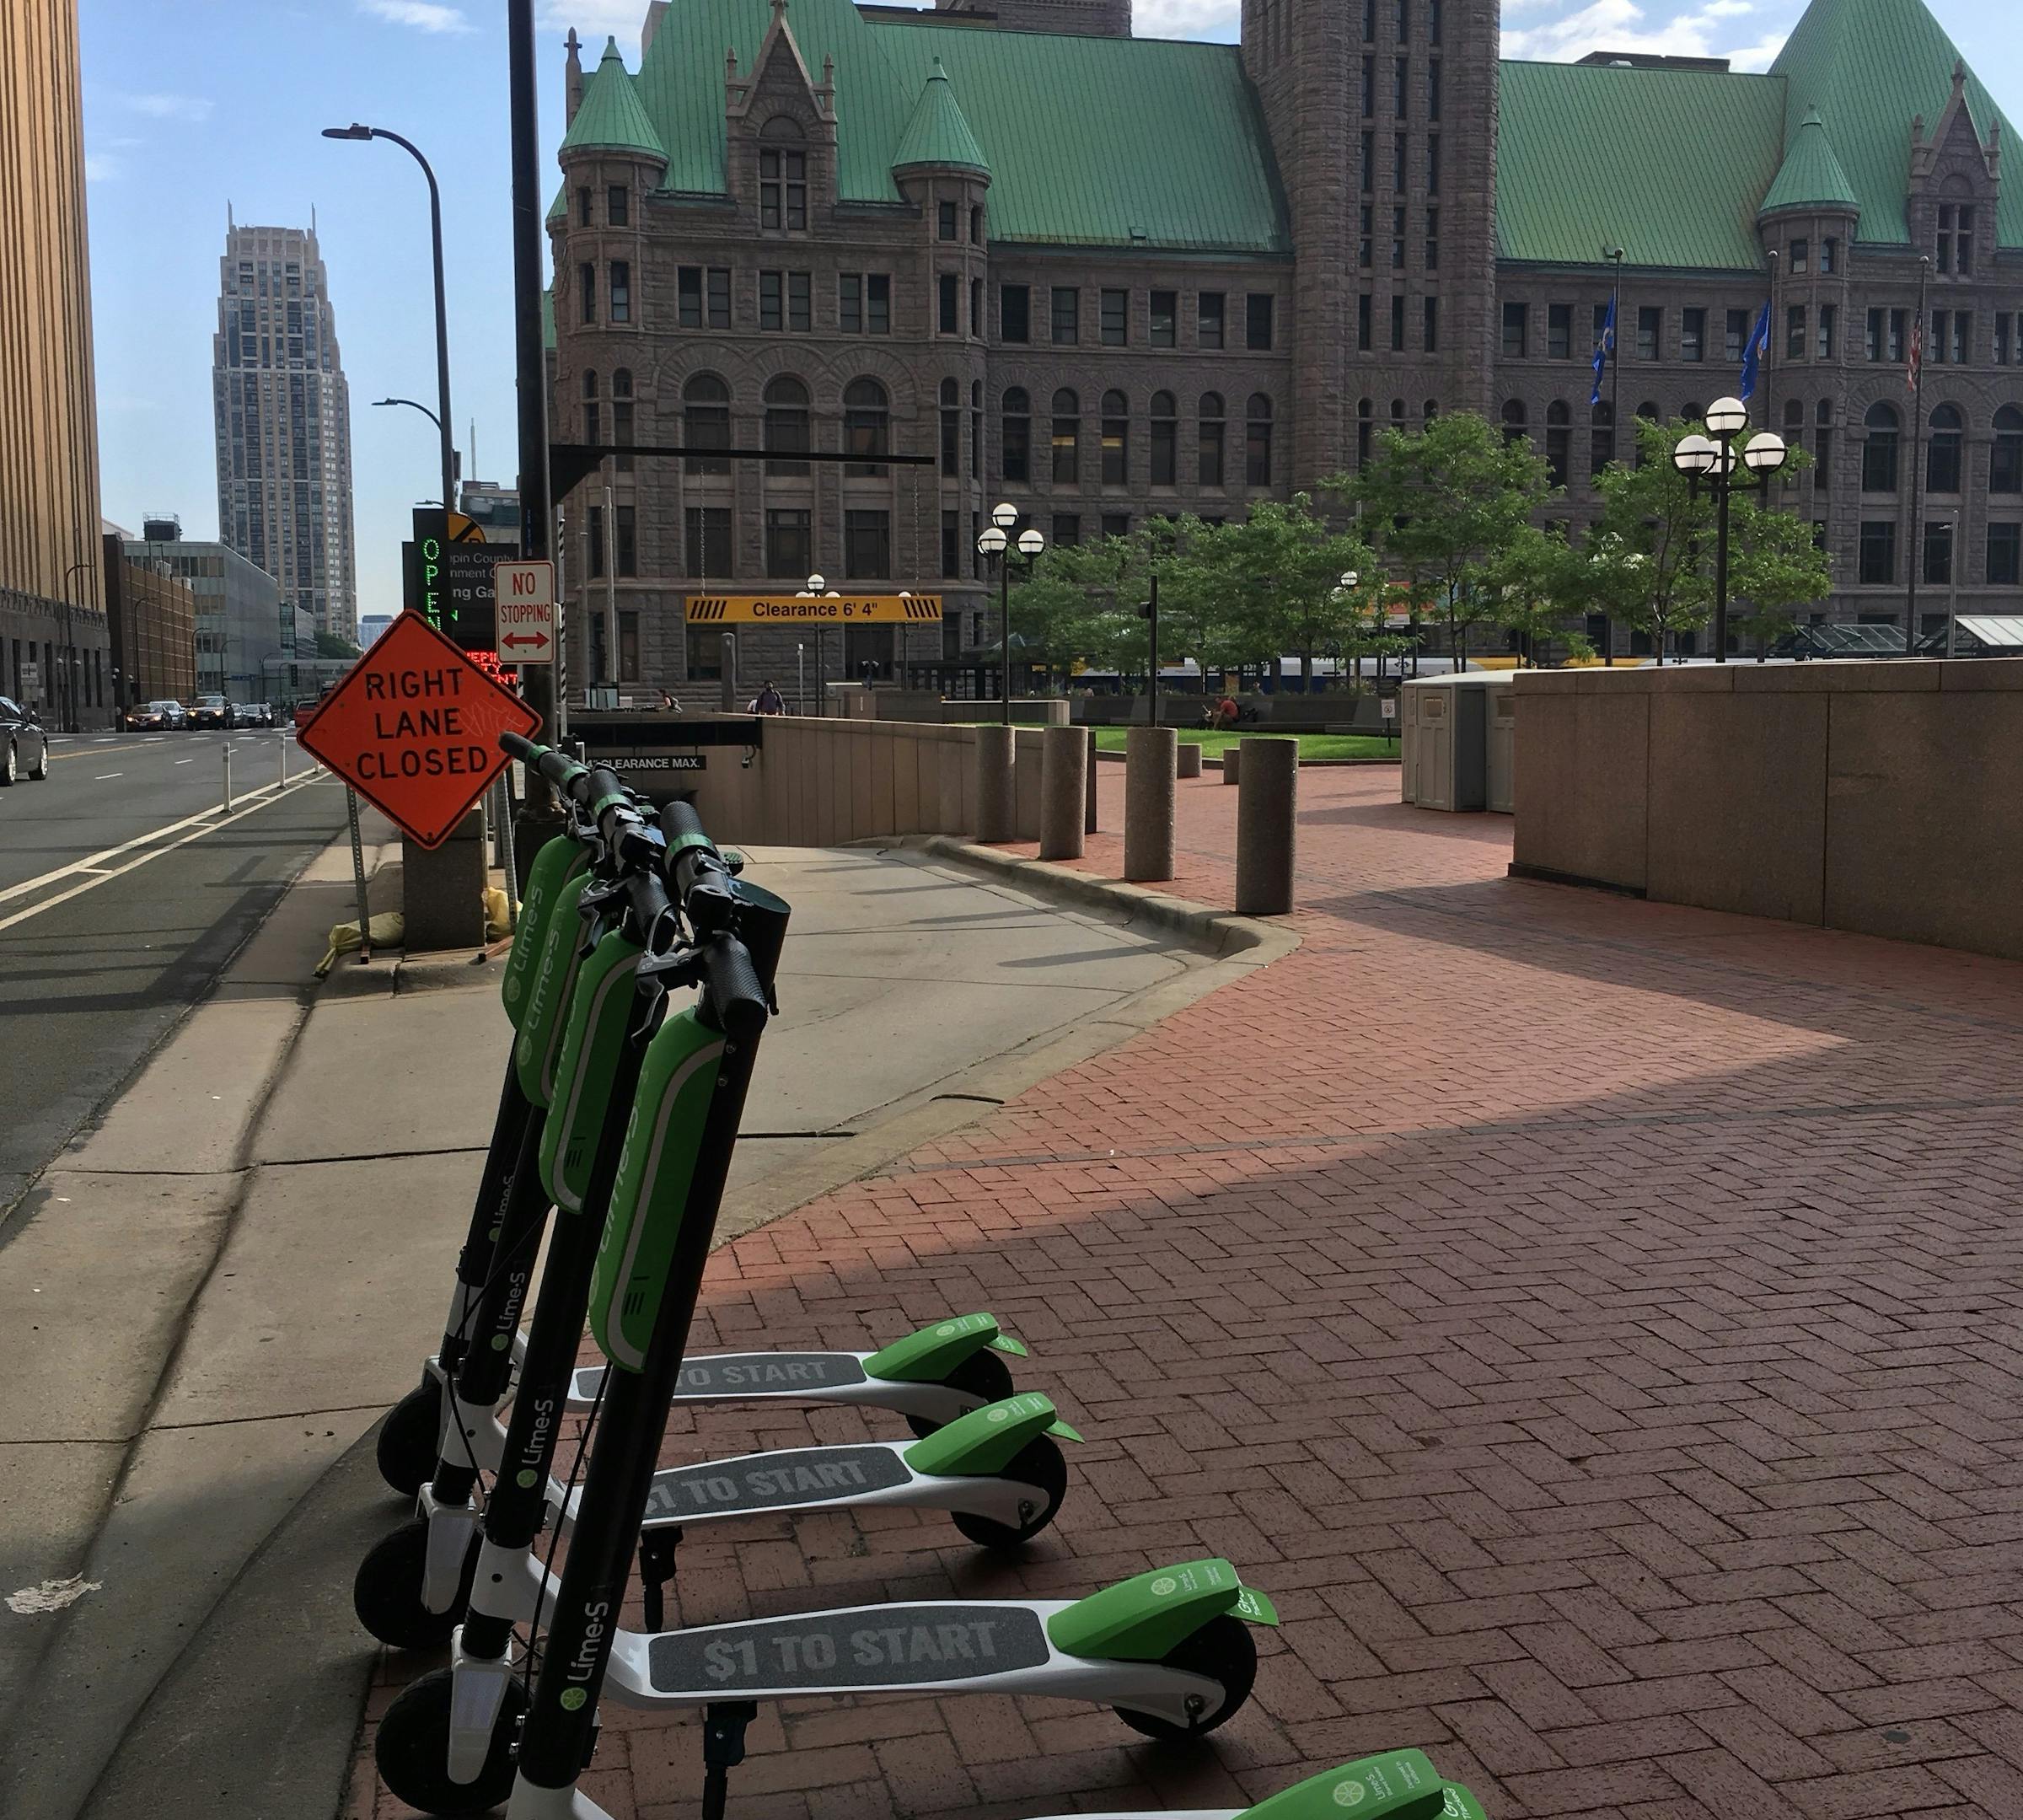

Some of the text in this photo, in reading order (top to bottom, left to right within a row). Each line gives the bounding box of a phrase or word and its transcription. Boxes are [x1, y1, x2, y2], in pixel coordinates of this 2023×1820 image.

[512, 572, 535, 596] NO
[501, 604, 550, 623] STOPPING
[753, 602, 837, 617] Clearance
[366, 668, 463, 701] RIGHT
[375, 708, 463, 739] LANE
[357, 746, 488, 780] CLOSED
[722, 1361, 826, 1383] START
[681, 1476, 739, 1505] TO
[745, 1460, 867, 1496] START
[703, 1621, 998, 1682] $1 TO START
